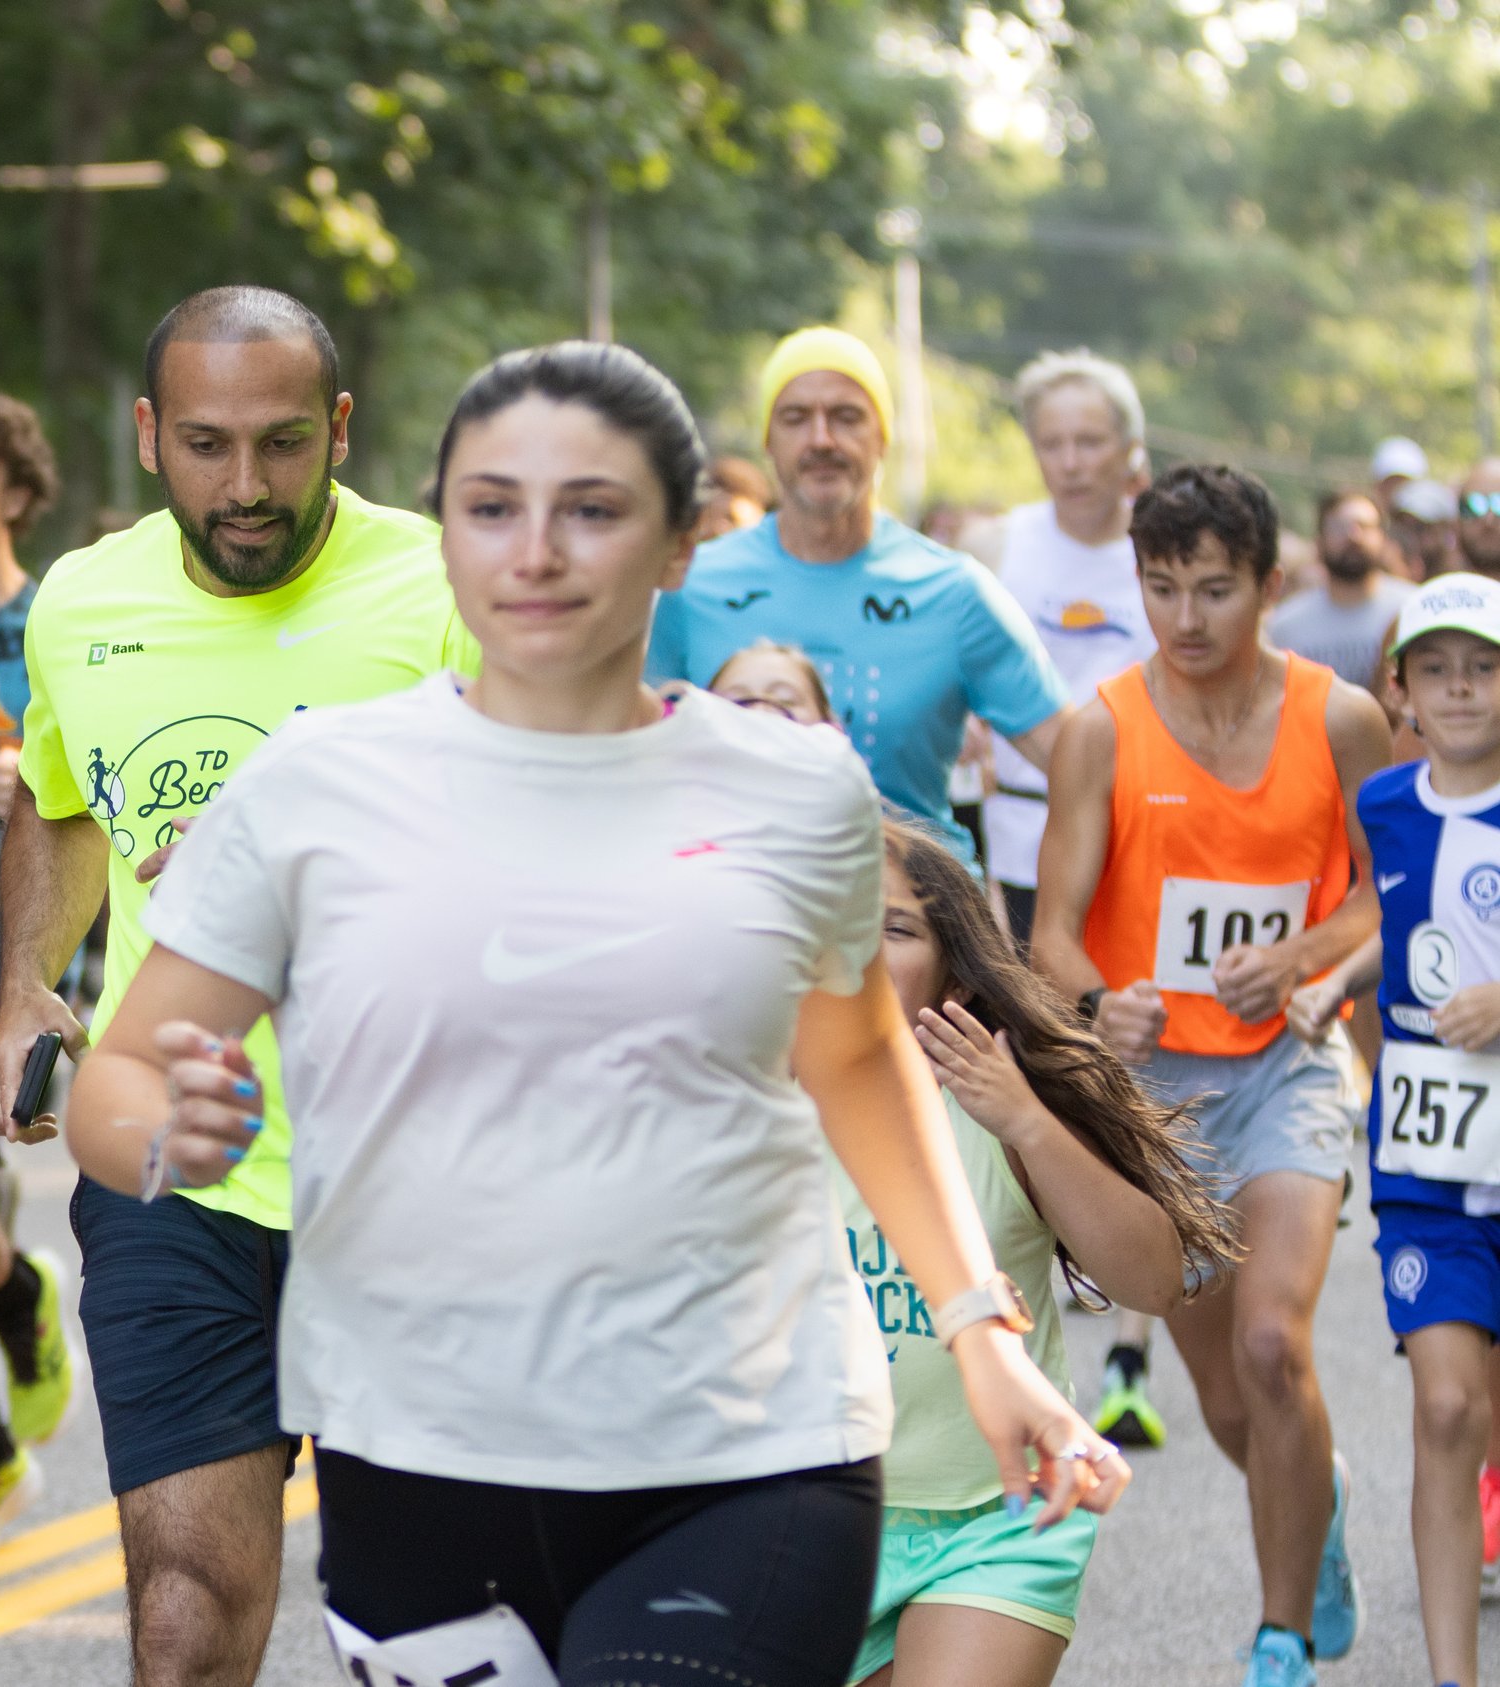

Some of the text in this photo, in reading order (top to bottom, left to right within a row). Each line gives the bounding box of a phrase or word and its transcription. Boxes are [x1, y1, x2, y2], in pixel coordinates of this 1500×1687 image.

[111, 641, 145, 655] Bank
[196, 750, 228, 771] TD
[1391, 1075, 1490, 1151] 257
